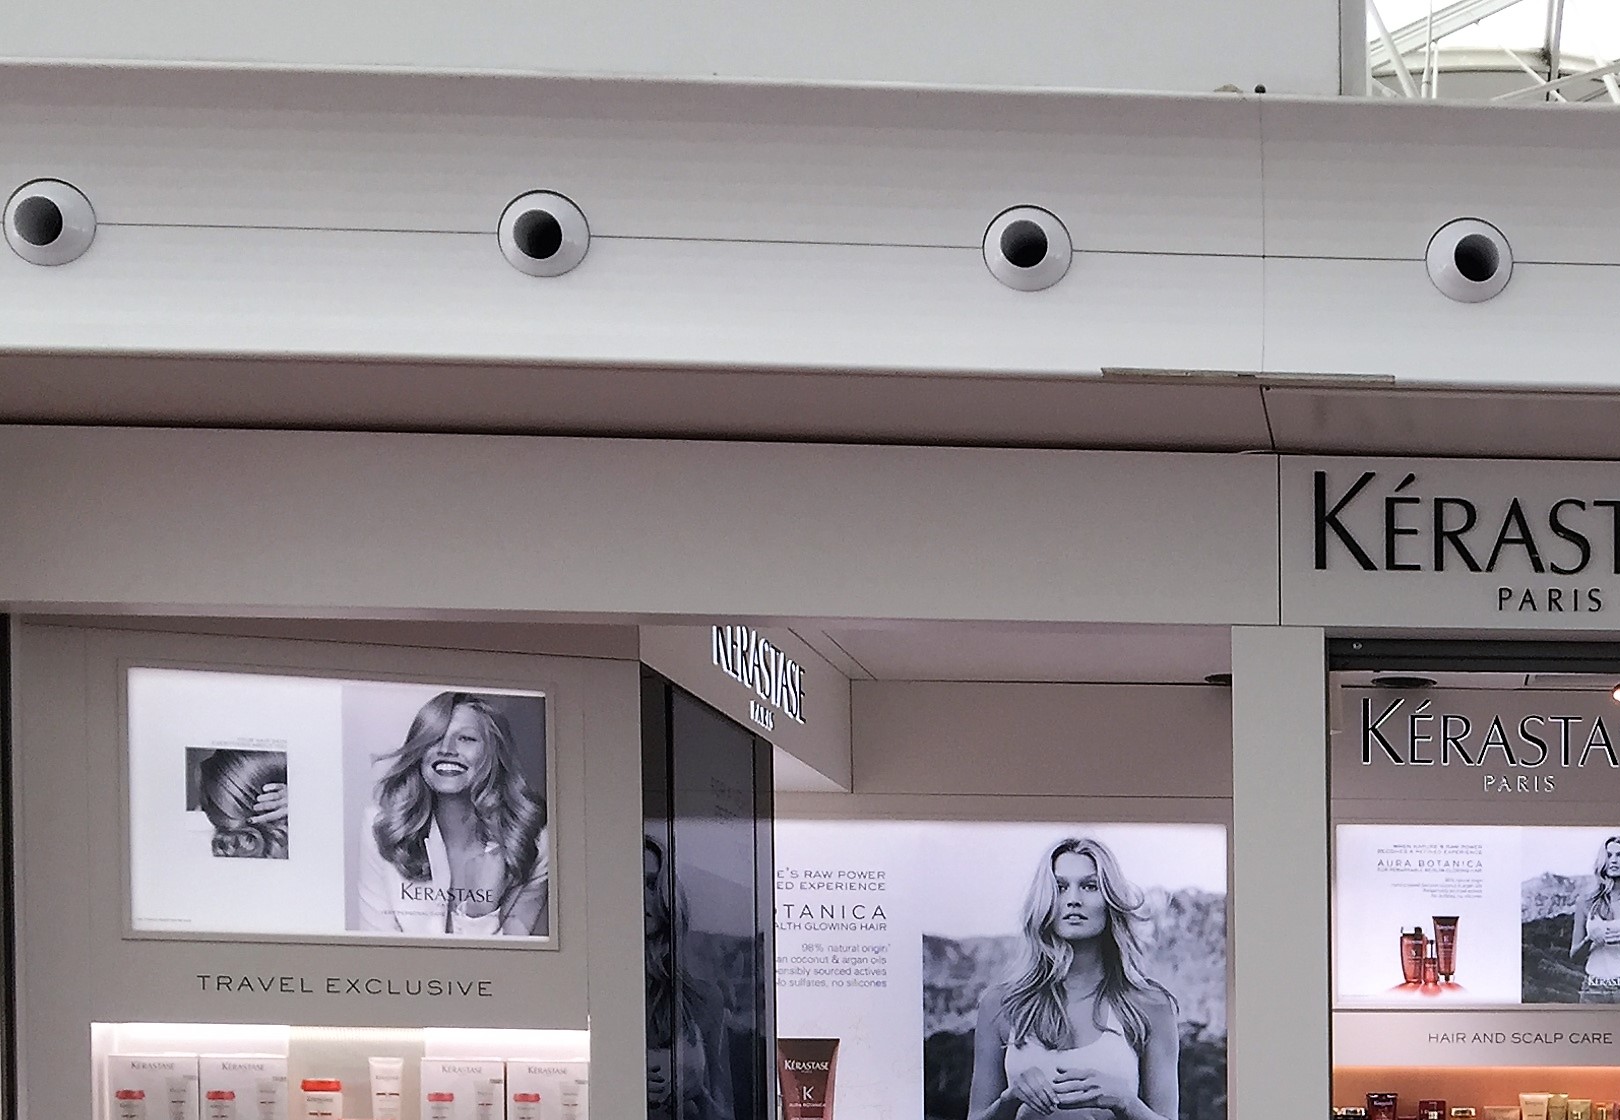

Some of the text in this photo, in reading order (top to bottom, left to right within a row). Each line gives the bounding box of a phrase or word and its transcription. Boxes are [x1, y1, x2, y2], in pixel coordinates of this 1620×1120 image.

[1497, 587, 1602, 612] PARIS
[1484, 774, 1556, 793] PARIS
[1377, 859, 1483, 868] AURA BOTANICA
[804, 870, 833, 879] RAW
[838, 871, 886, 880] POWER
[800, 882, 886, 891] EXPERIENCE
[775, 904, 887, 920] TANICA
[804, 922, 857, 931] GLOWING
[860, 923, 887, 931] HAIR
[791, 956, 829, 964] coconut
[831, 954, 839, 964] &
[842, 956, 868, 966] argan
[871, 955, 887, 964] oils
[814, 966, 851, 975] sourced
[854, 967, 887, 975] actives
[197, 975, 493, 997] TRAVEL EXCLUSIVE
[1428, 1032, 1613, 1045] HAIR AND SCALP CARE
[803, 1086, 815, 1101] K
